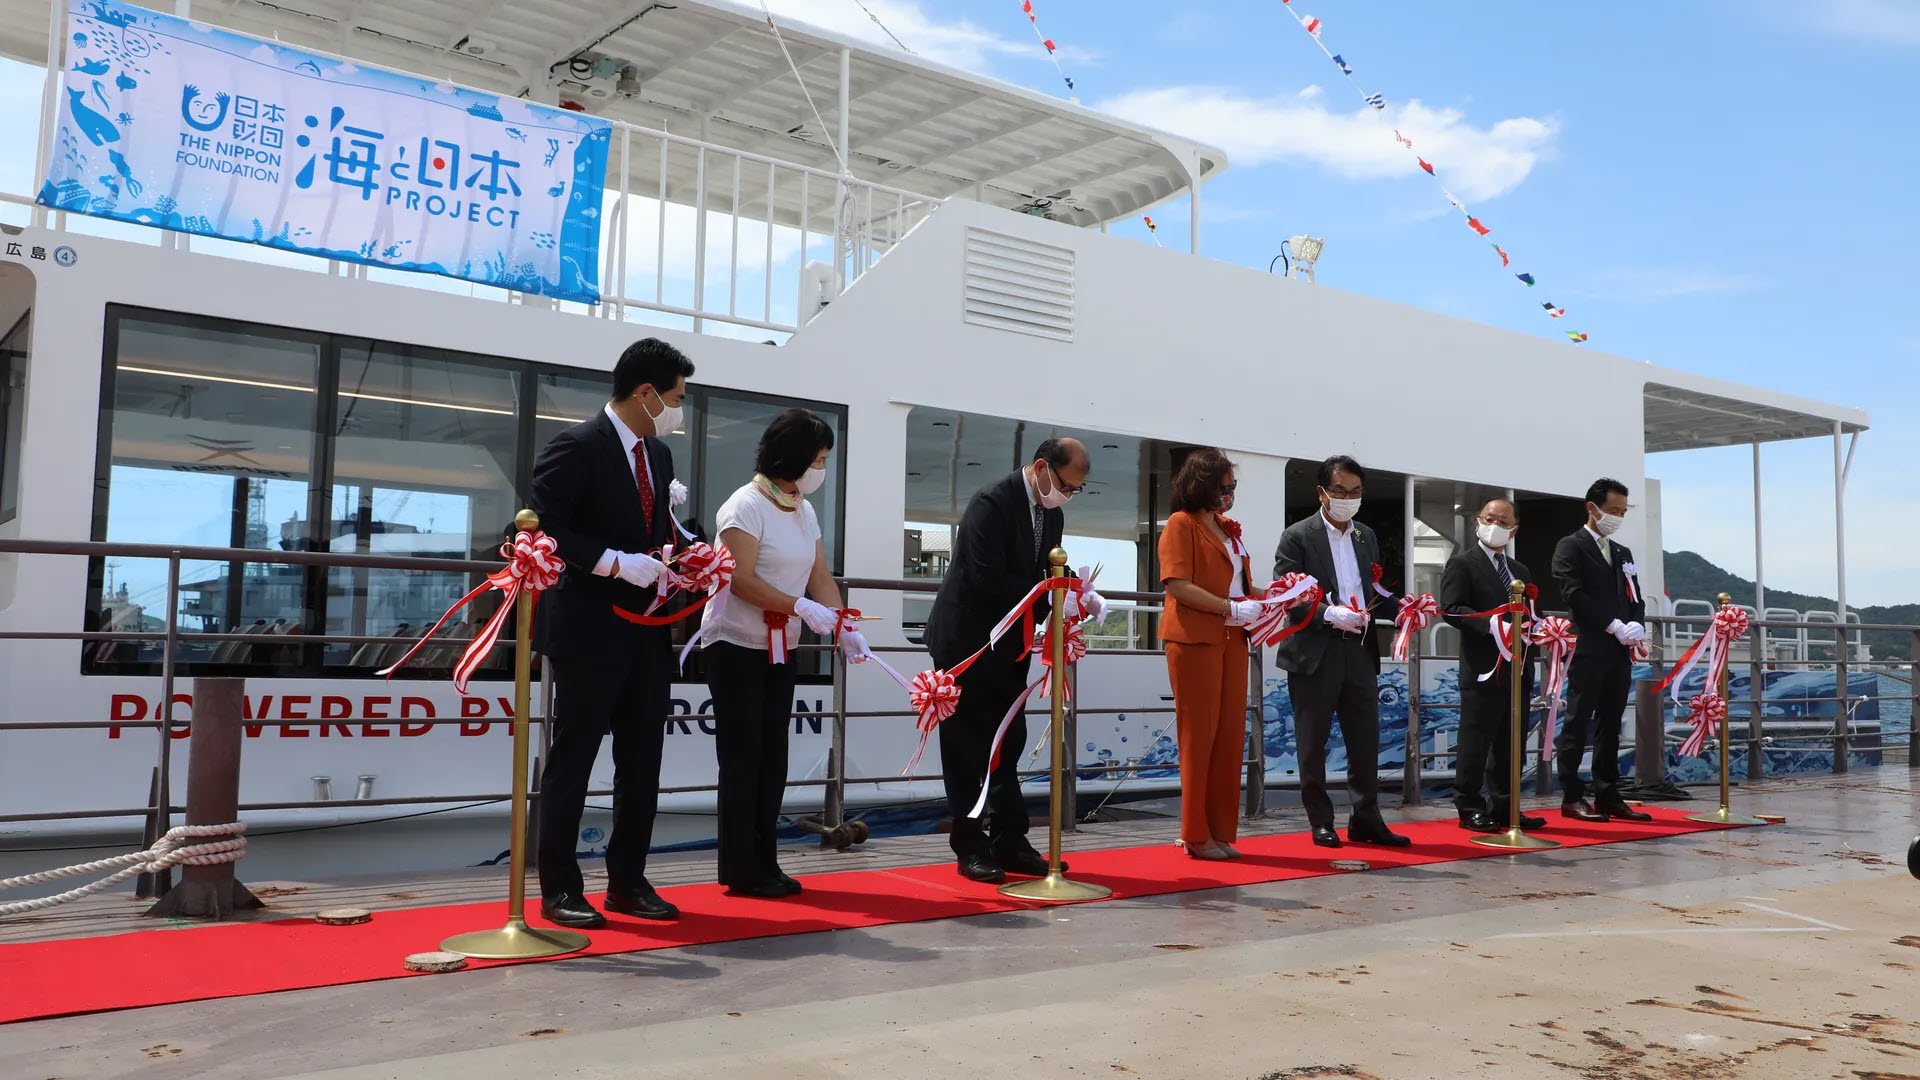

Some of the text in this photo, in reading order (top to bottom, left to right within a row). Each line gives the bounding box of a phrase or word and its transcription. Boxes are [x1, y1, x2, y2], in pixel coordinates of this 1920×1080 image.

[234, 95, 285, 123] 日本
[180, 133, 281, 167] THE NIPPON
[233, 118, 284, 149] 財団
[176, 150, 279, 184] FOUNDATION
[295, 106, 522, 201] 海と日本
[386, 186, 520, 229] PROJECT
[6, 242, 47, 261] 広島
